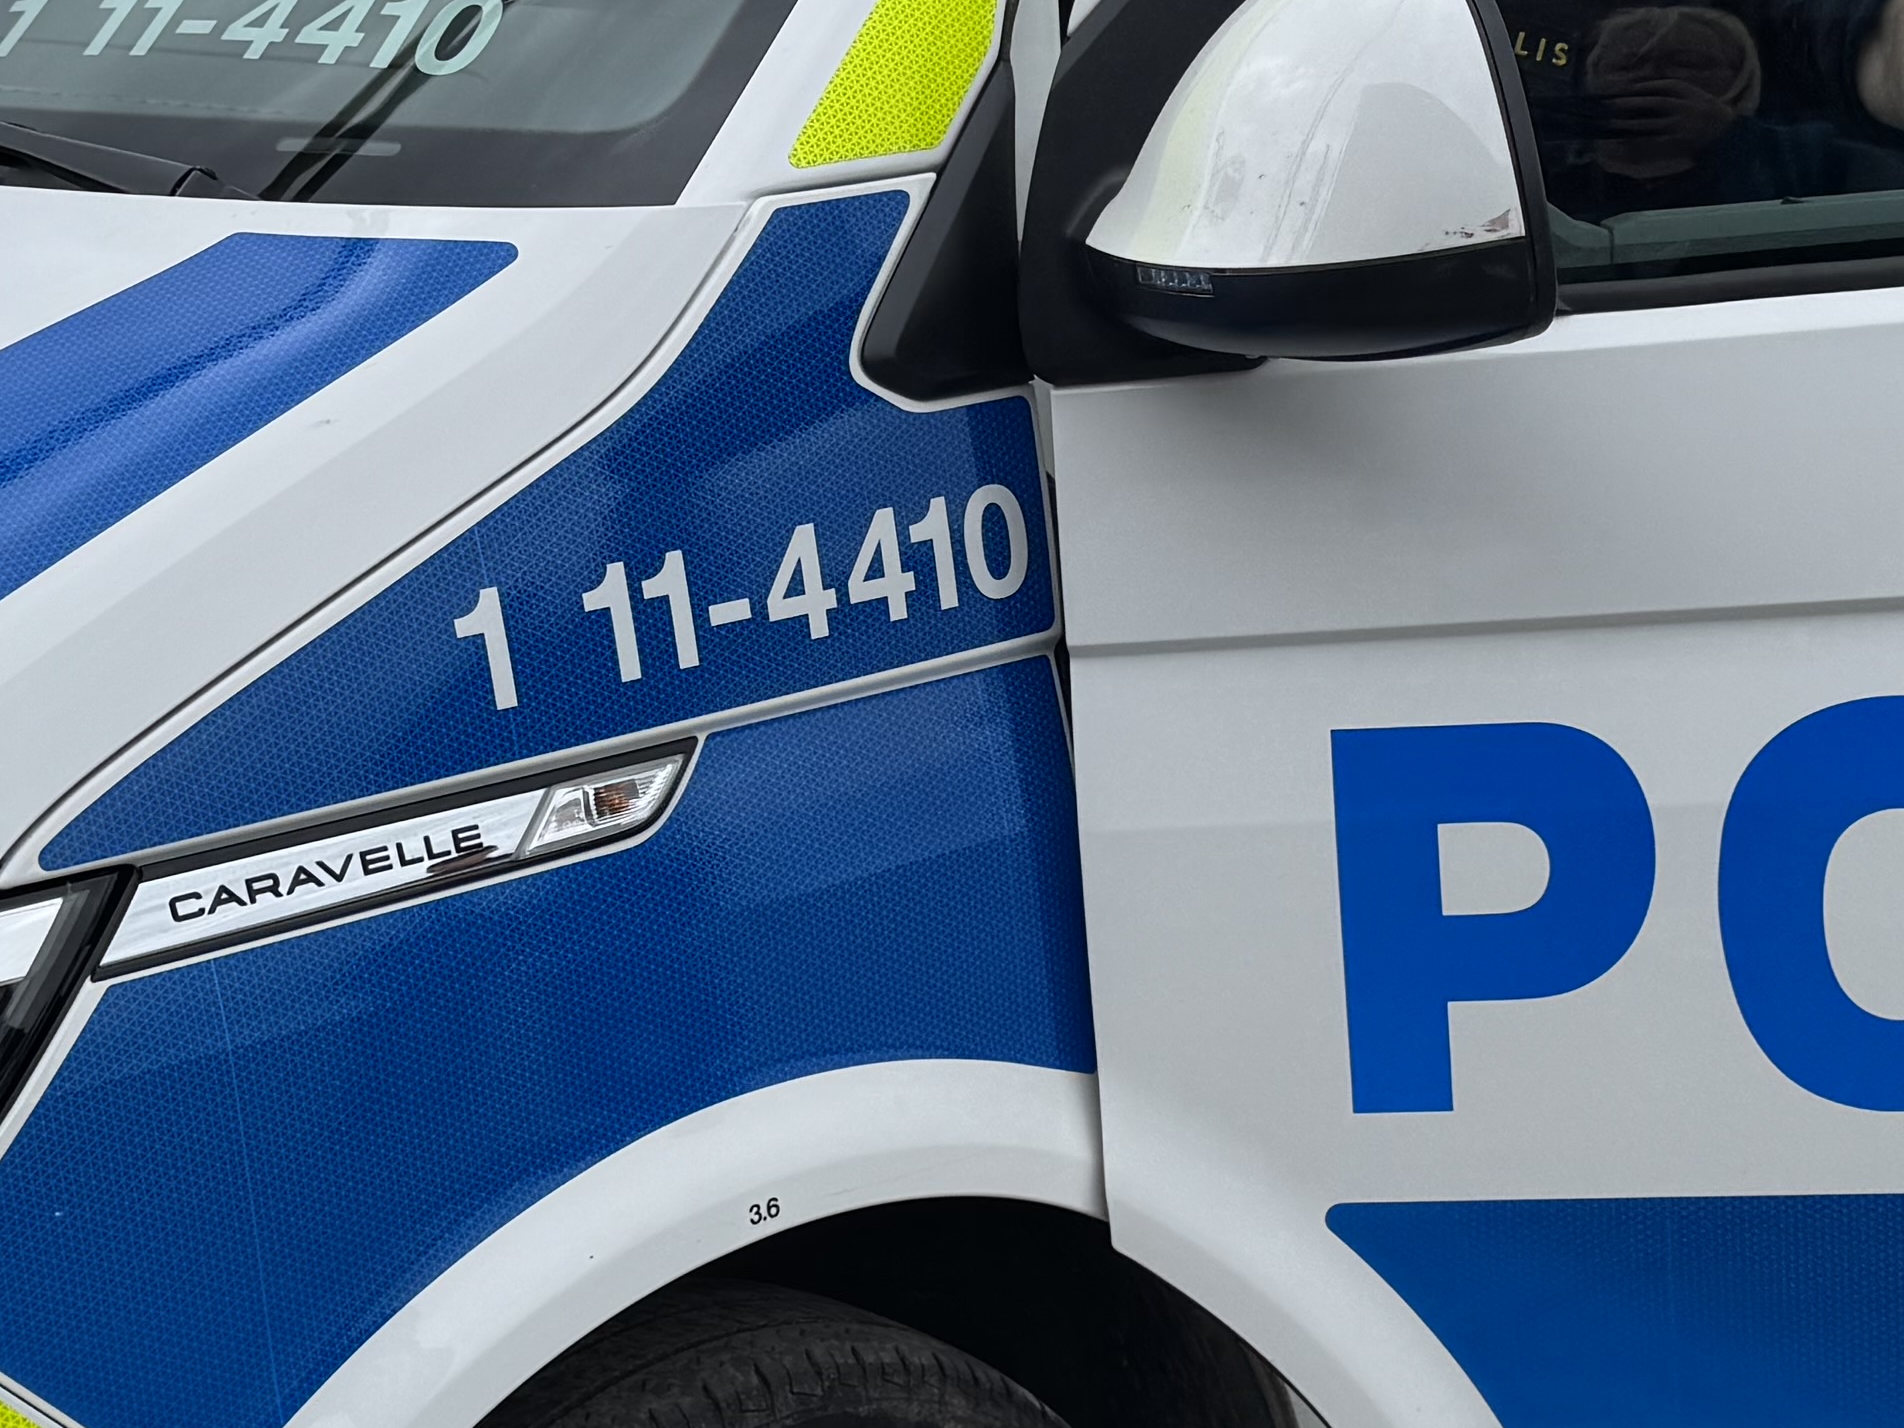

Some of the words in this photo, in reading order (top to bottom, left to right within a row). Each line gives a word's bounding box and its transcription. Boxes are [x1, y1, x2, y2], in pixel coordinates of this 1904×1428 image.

[1514, 31, 1569, 67] LIS
[453, 586, 519, 711] 1
[582, 483, 1029, 681] 11-4410
[168, 824, 484, 922] CARAVELLE
[749, 1197, 780, 1225] 3.6
